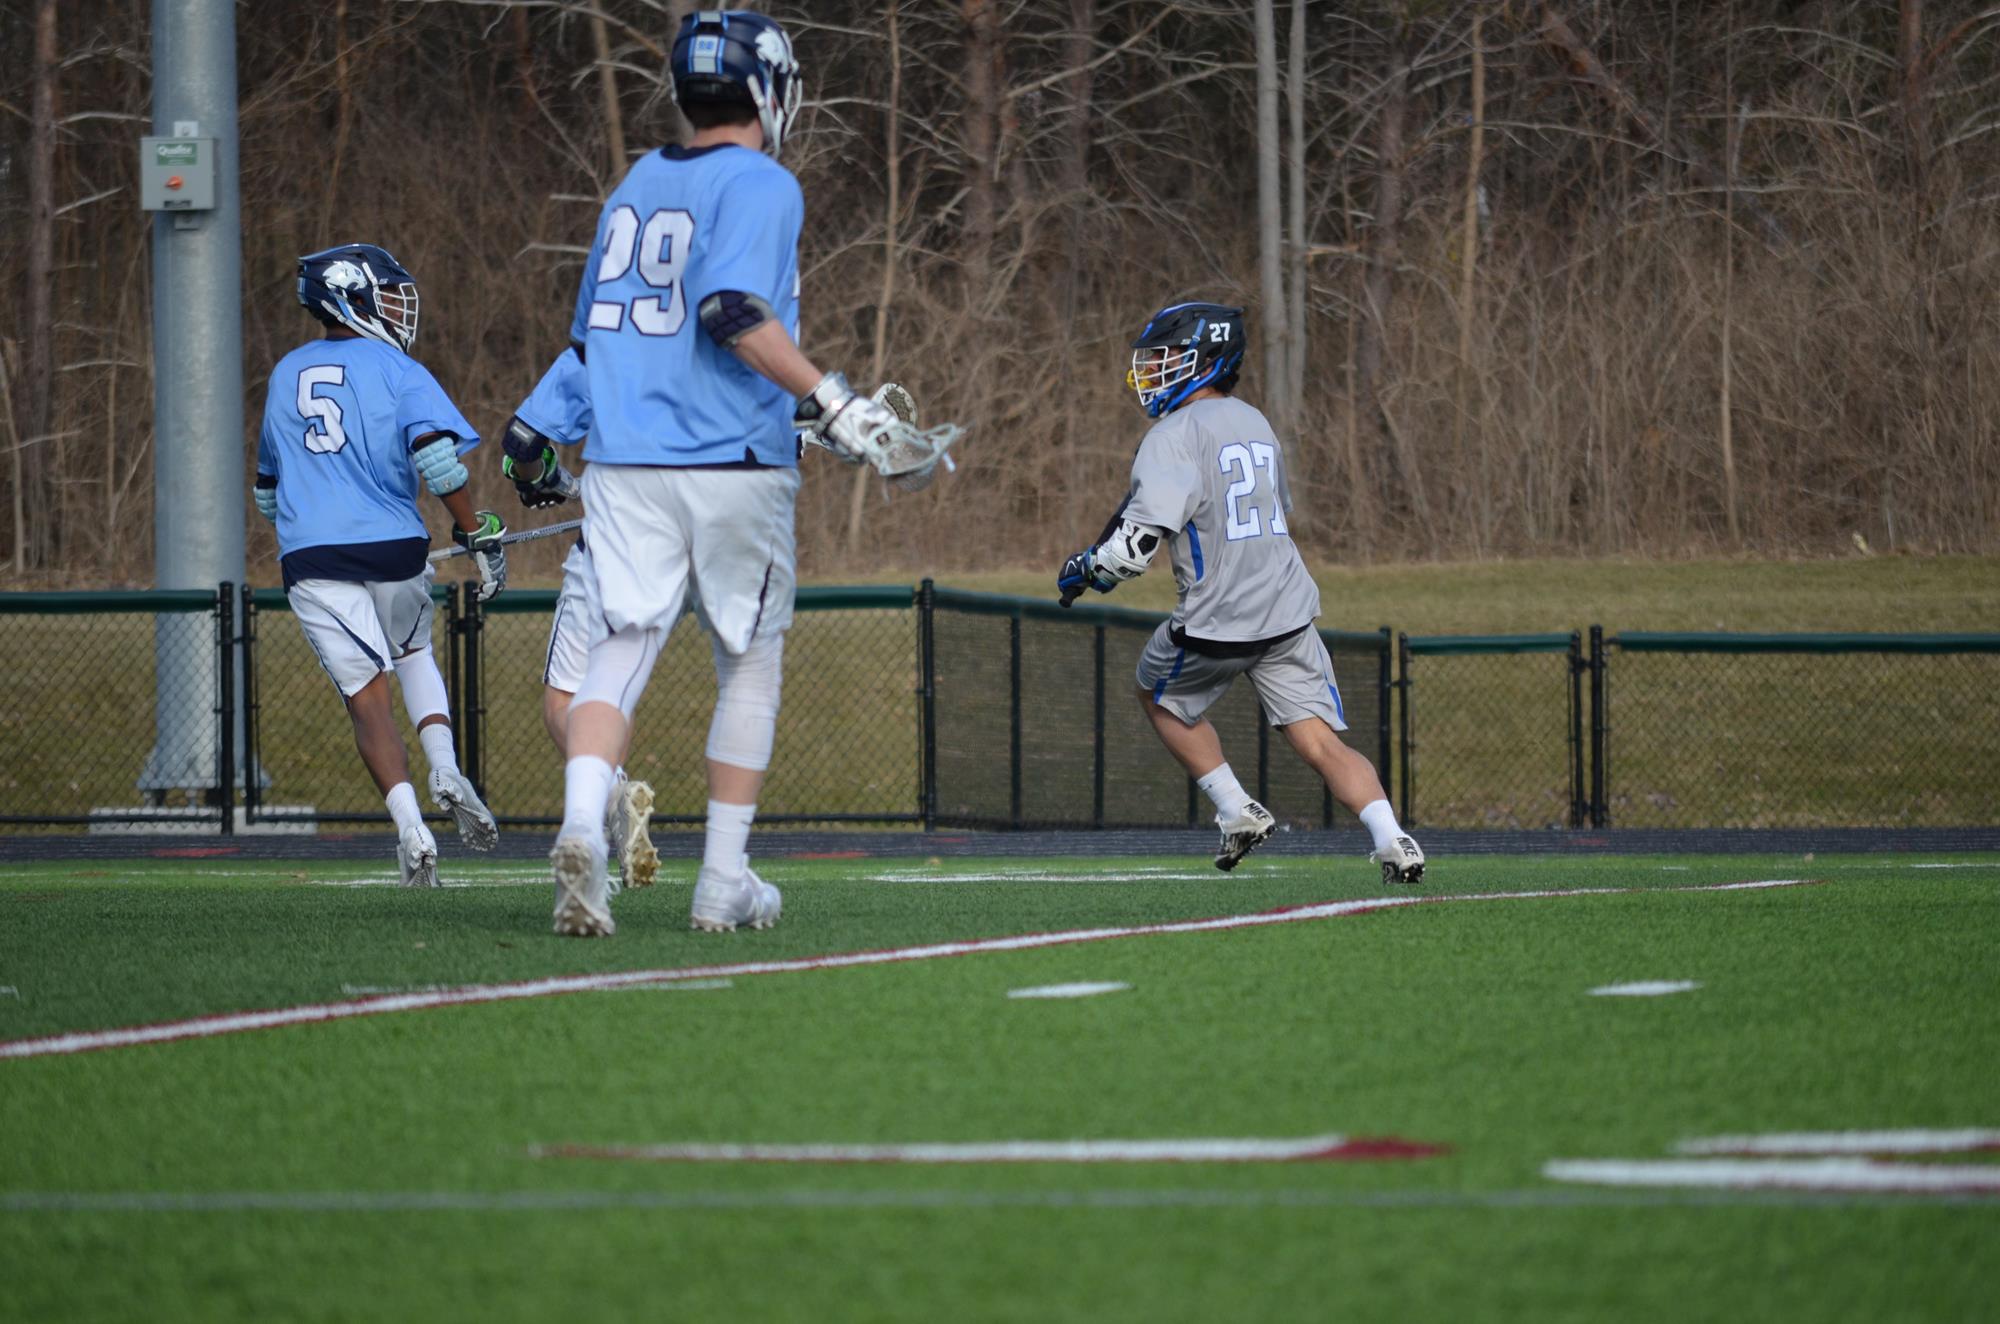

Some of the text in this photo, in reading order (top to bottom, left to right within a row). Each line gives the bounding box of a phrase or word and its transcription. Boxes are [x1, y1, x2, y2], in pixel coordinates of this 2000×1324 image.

[588, 205, 695, 337] 29
[1208, 322, 1230, 343] 27
[296, 364, 347, 454] 5
[1218, 441, 1288, 542] 27
[1243, 802, 1271, 820] NIKE
[1396, 836, 1419, 857] NIKE
